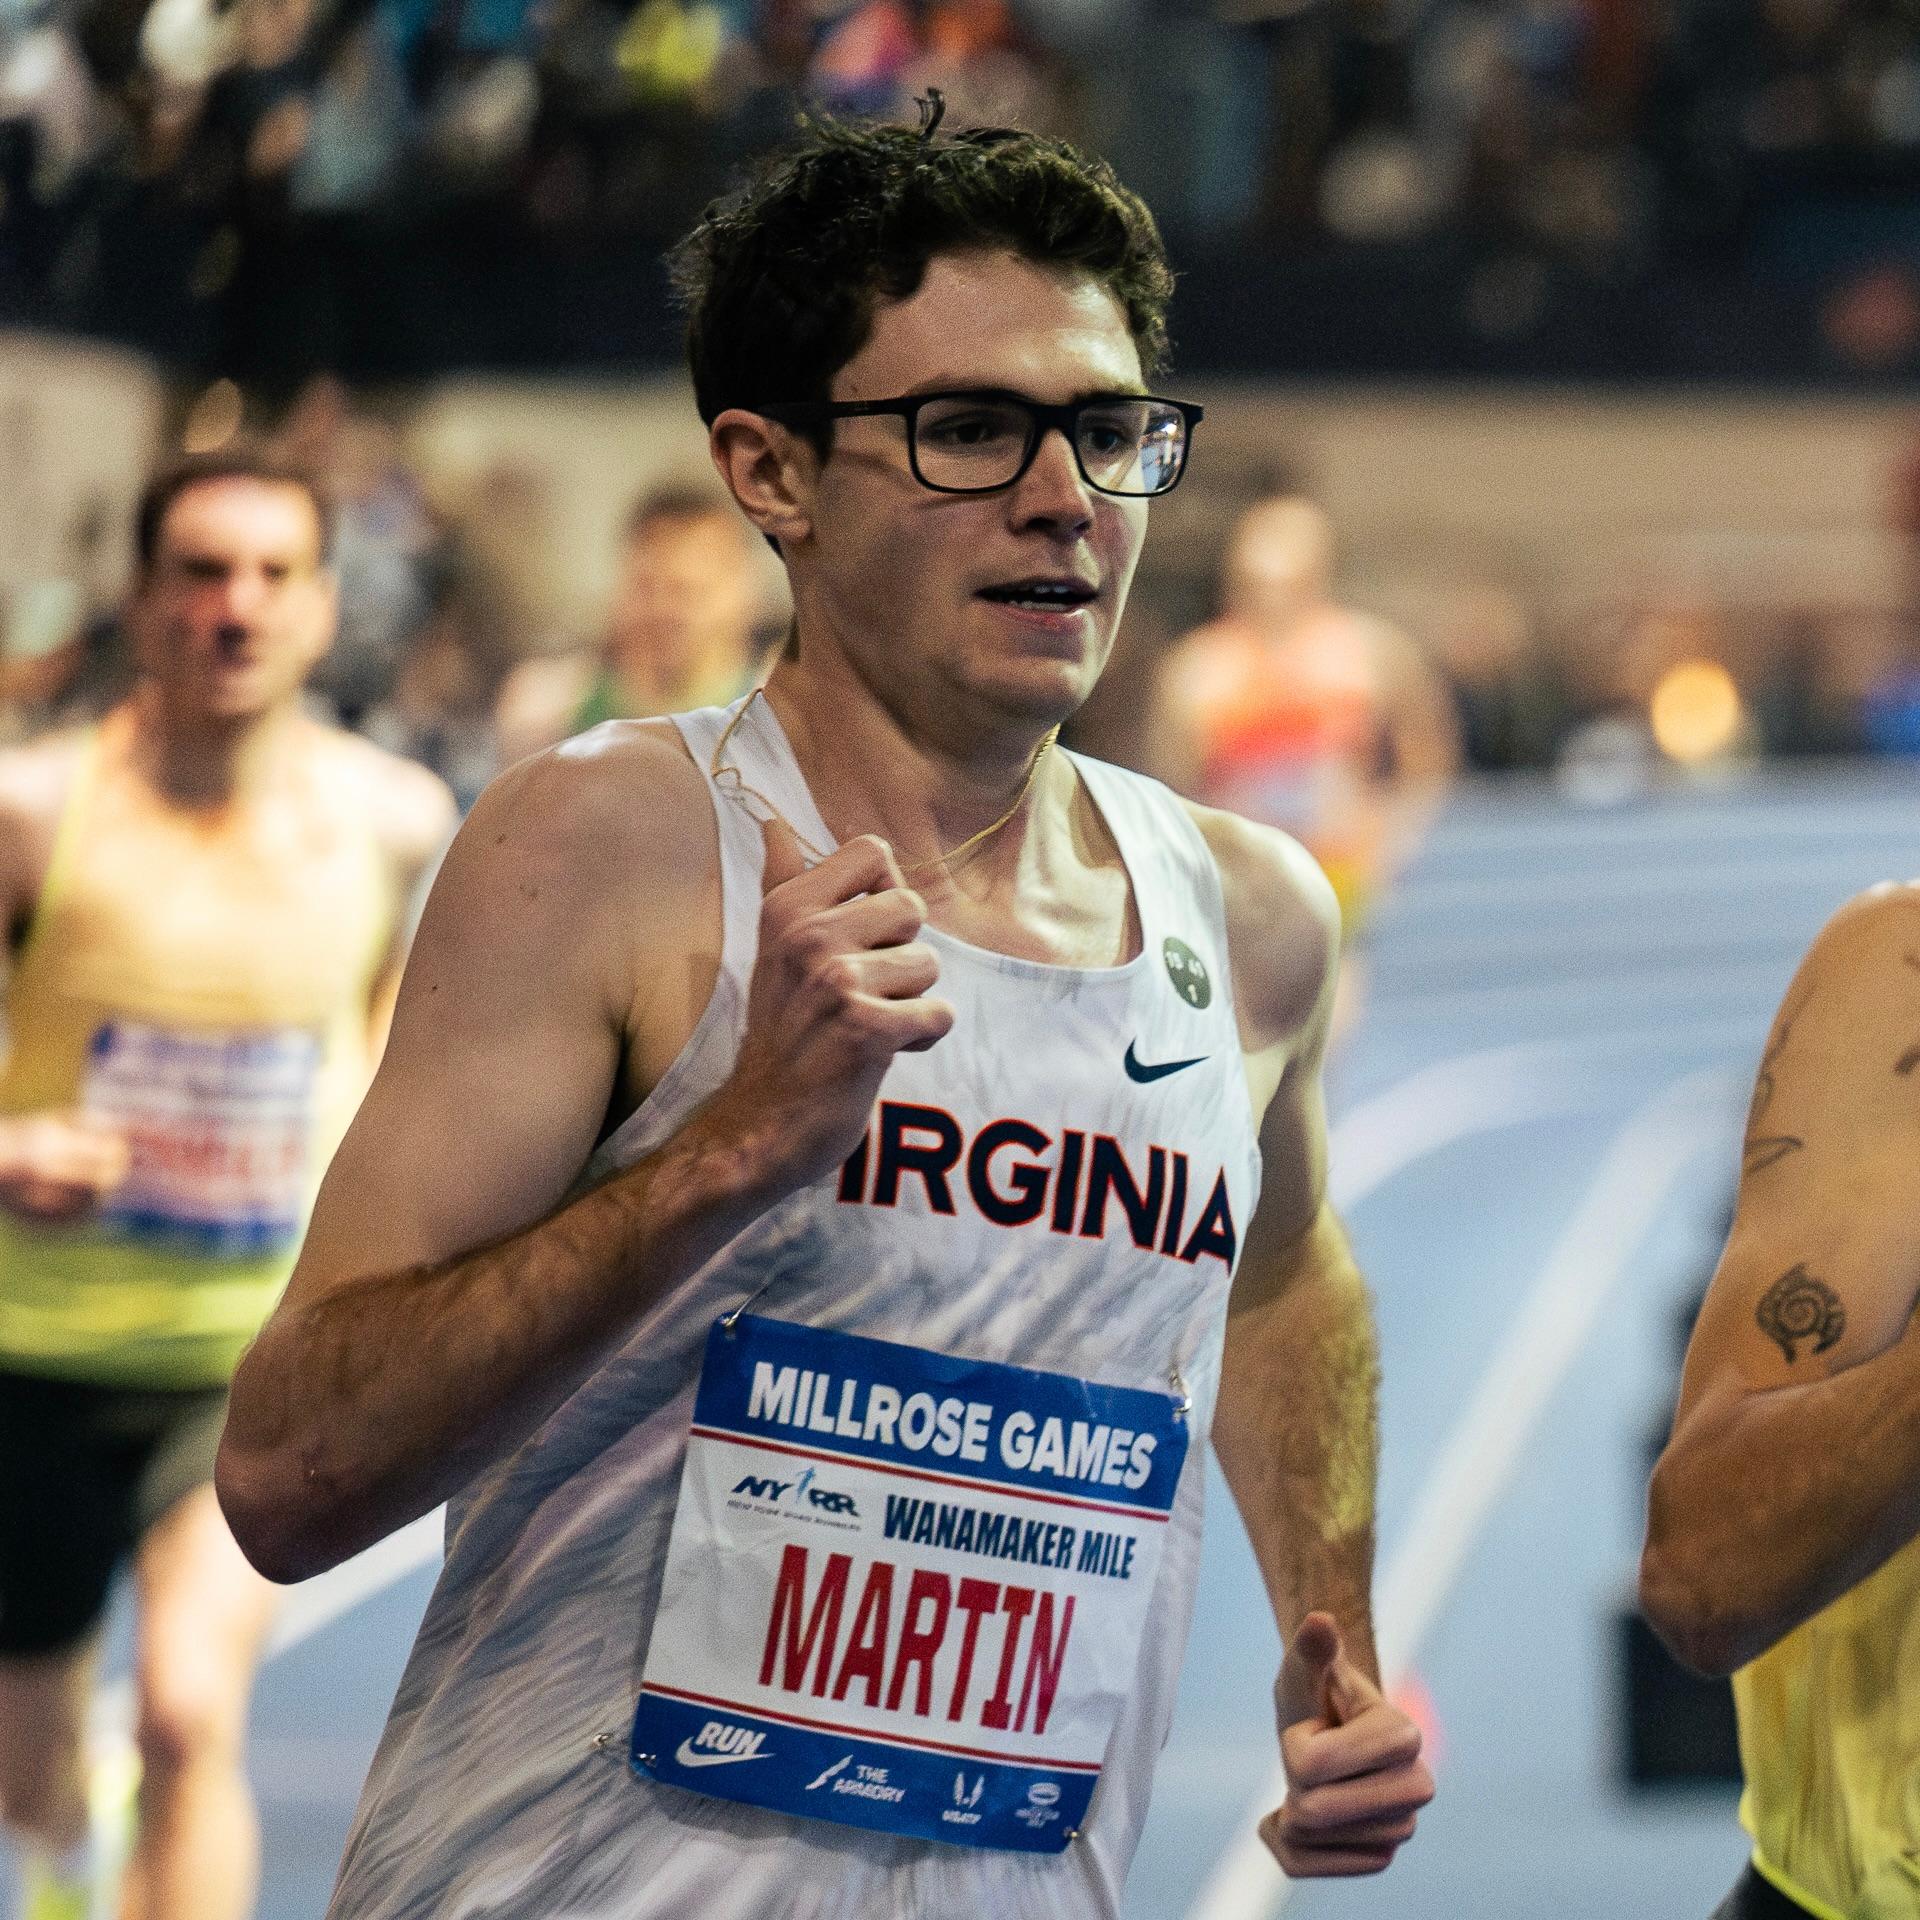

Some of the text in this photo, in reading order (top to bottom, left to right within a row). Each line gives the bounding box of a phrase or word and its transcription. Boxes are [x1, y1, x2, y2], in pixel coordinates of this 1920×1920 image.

[837, 1099, 1237, 1277] IRGINIA
[747, 1361, 1157, 1490] MILLROSE GAMES
[884, 1494, 1076, 1569] WANAMAKER
[1076, 1529, 1136, 1579] MILE
[758, 1544, 1076, 1736] MARTIN
[695, 1720, 768, 1756] RUN
[856, 1765, 890, 1784] THE
